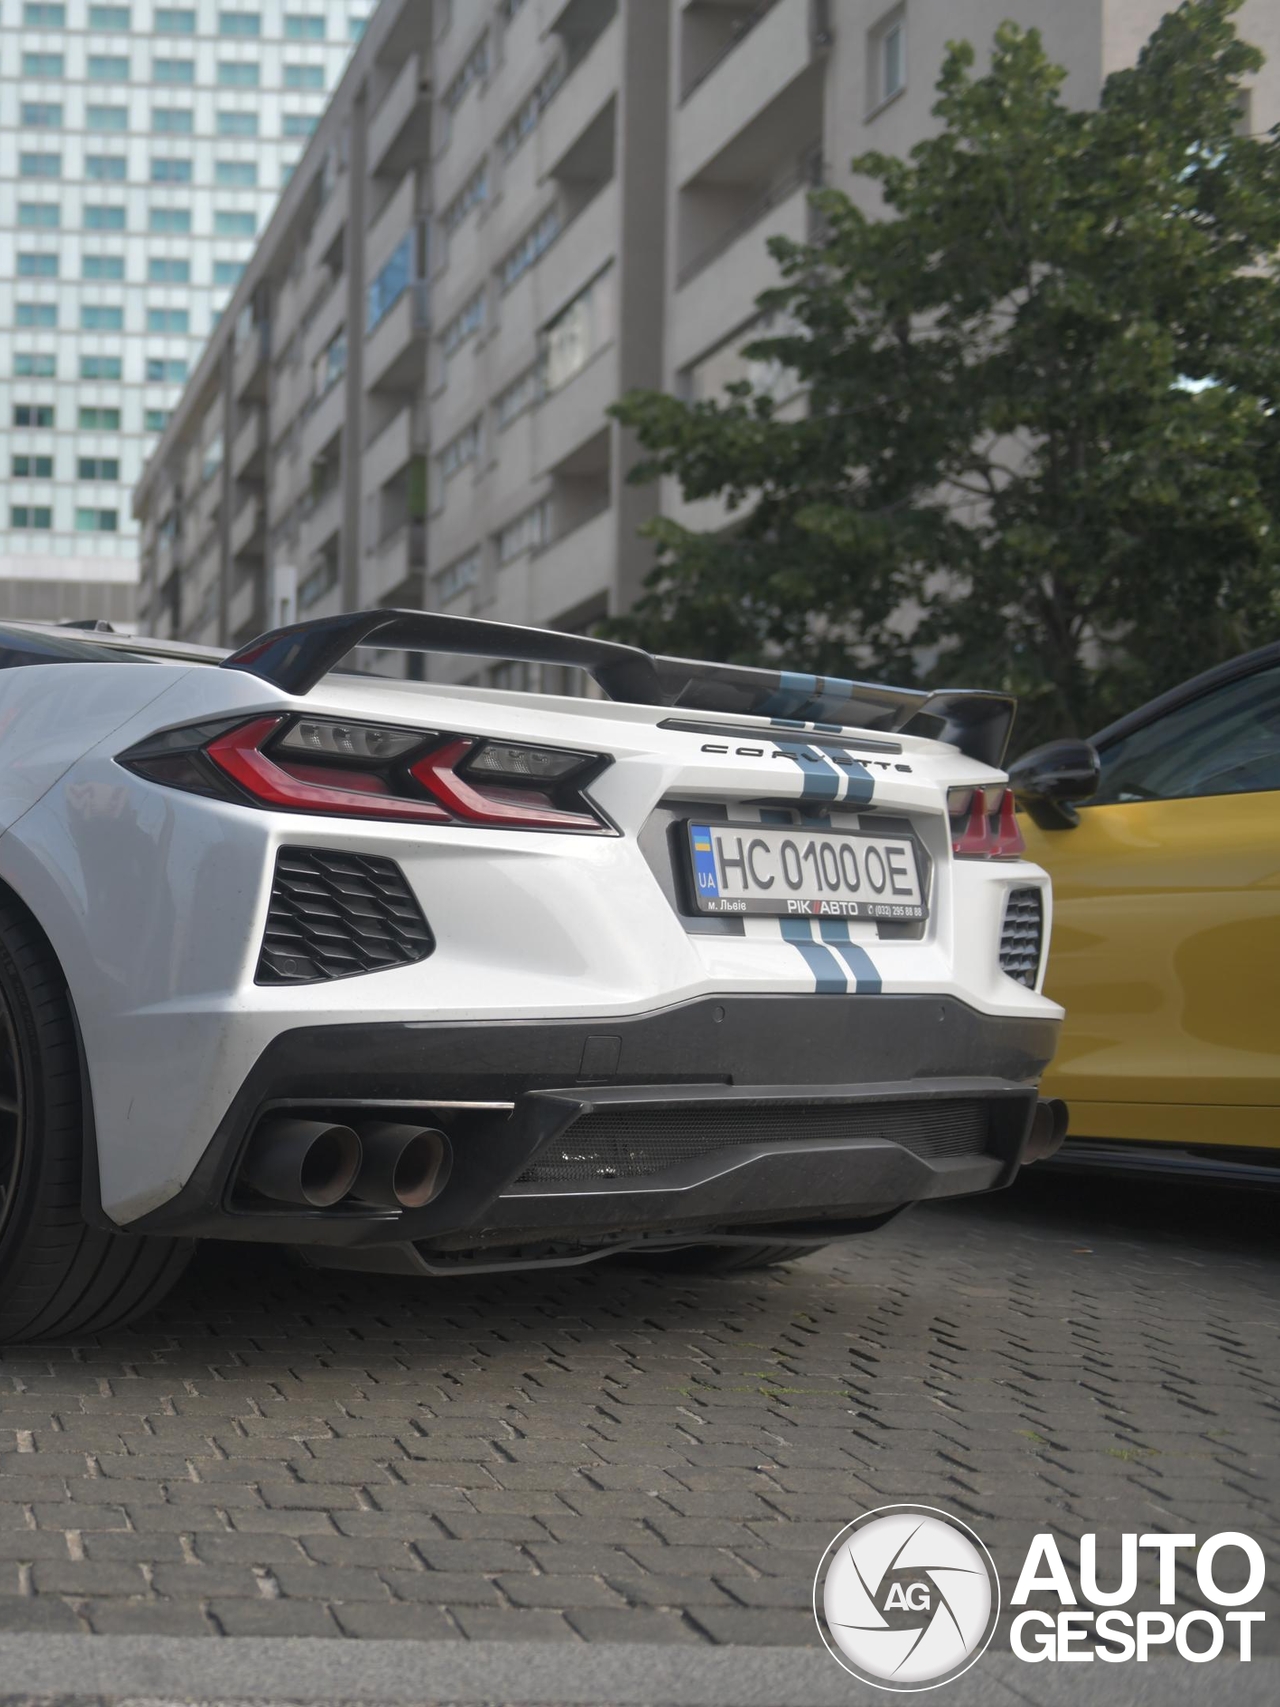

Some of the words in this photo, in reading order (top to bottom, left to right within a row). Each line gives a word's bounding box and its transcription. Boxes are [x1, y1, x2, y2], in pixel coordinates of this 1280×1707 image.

[700, 744, 913, 773] CORVETTE
[780, 839, 861, 893] 0100
[698, 872, 716, 889] UA
[875, 904, 892, 918] (032)
[892, 905, 905, 917] 295
[904, 906, 913, 917] 88
[913, 907, 923, 917] 88
